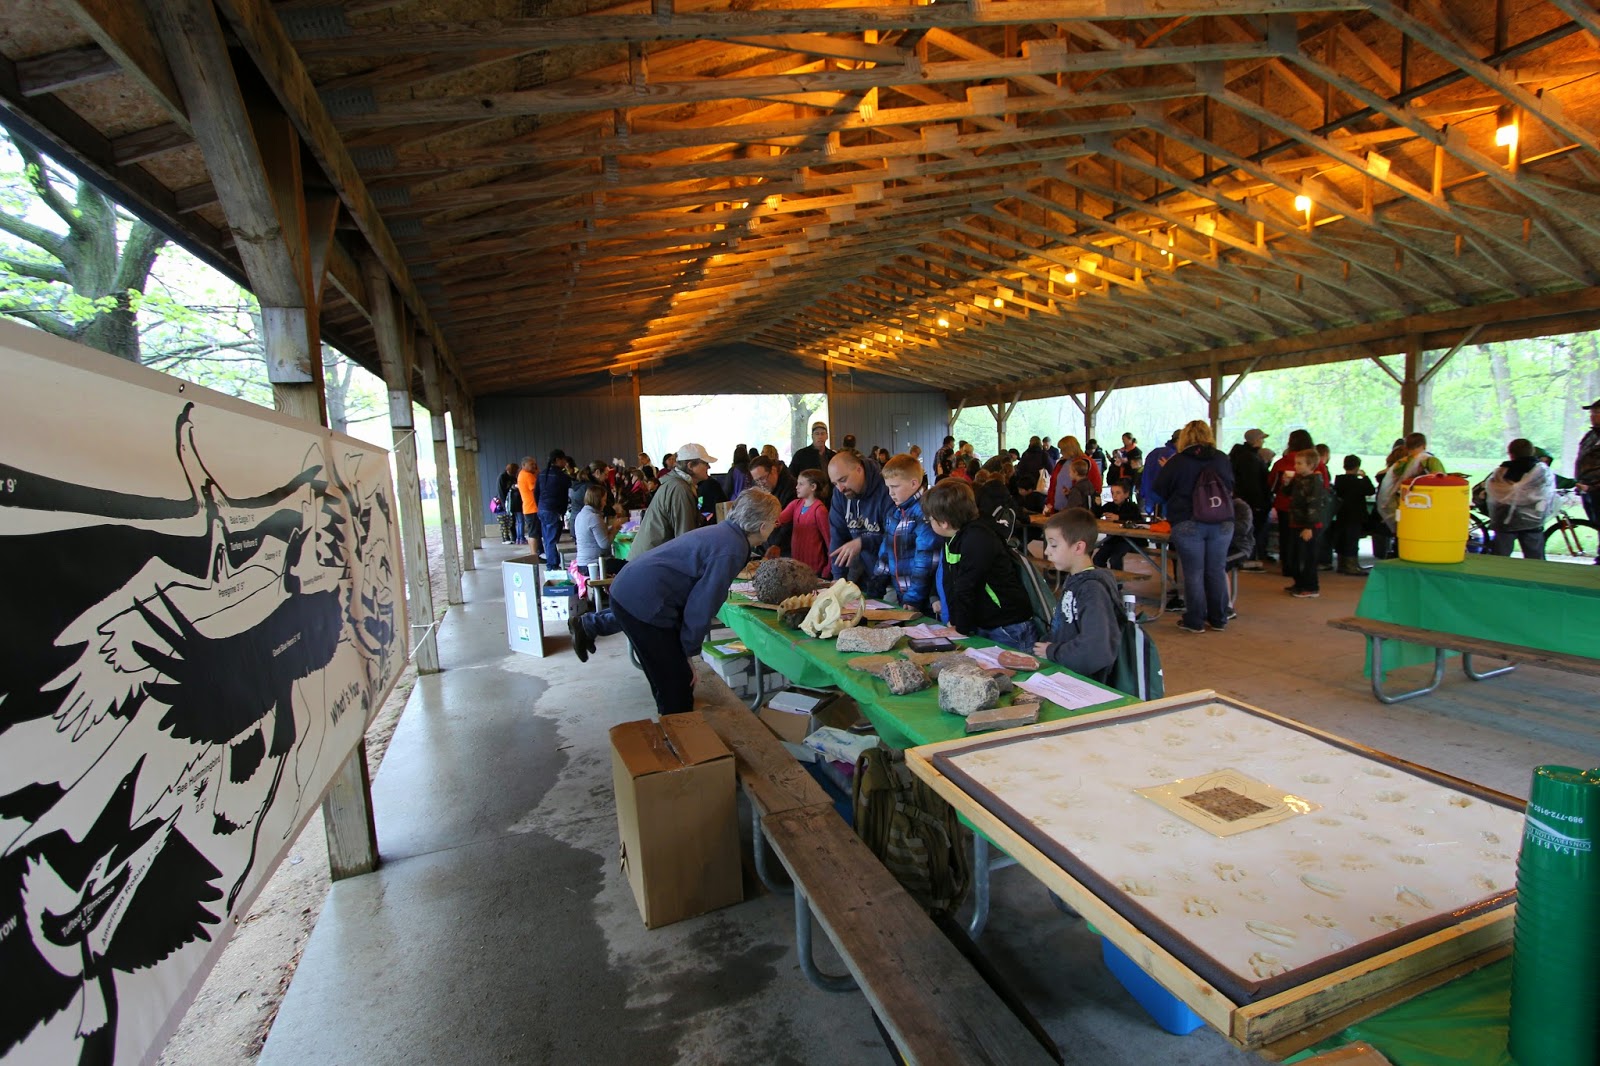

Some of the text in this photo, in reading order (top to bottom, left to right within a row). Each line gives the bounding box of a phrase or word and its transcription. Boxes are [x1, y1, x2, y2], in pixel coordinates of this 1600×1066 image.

[1209, 496, 1222, 508] D
[229, 541, 243, 552] Turkey
[330, 688, 351, 728] What's
[1524, 832, 1579, 857] ISABELL
[1534, 829, 1592, 850] CONSERVATION
[61, 885, 115, 938] Tufted Titmouse
[101, 896, 125, 946] American
[124, 864, 146, 895] Robin
